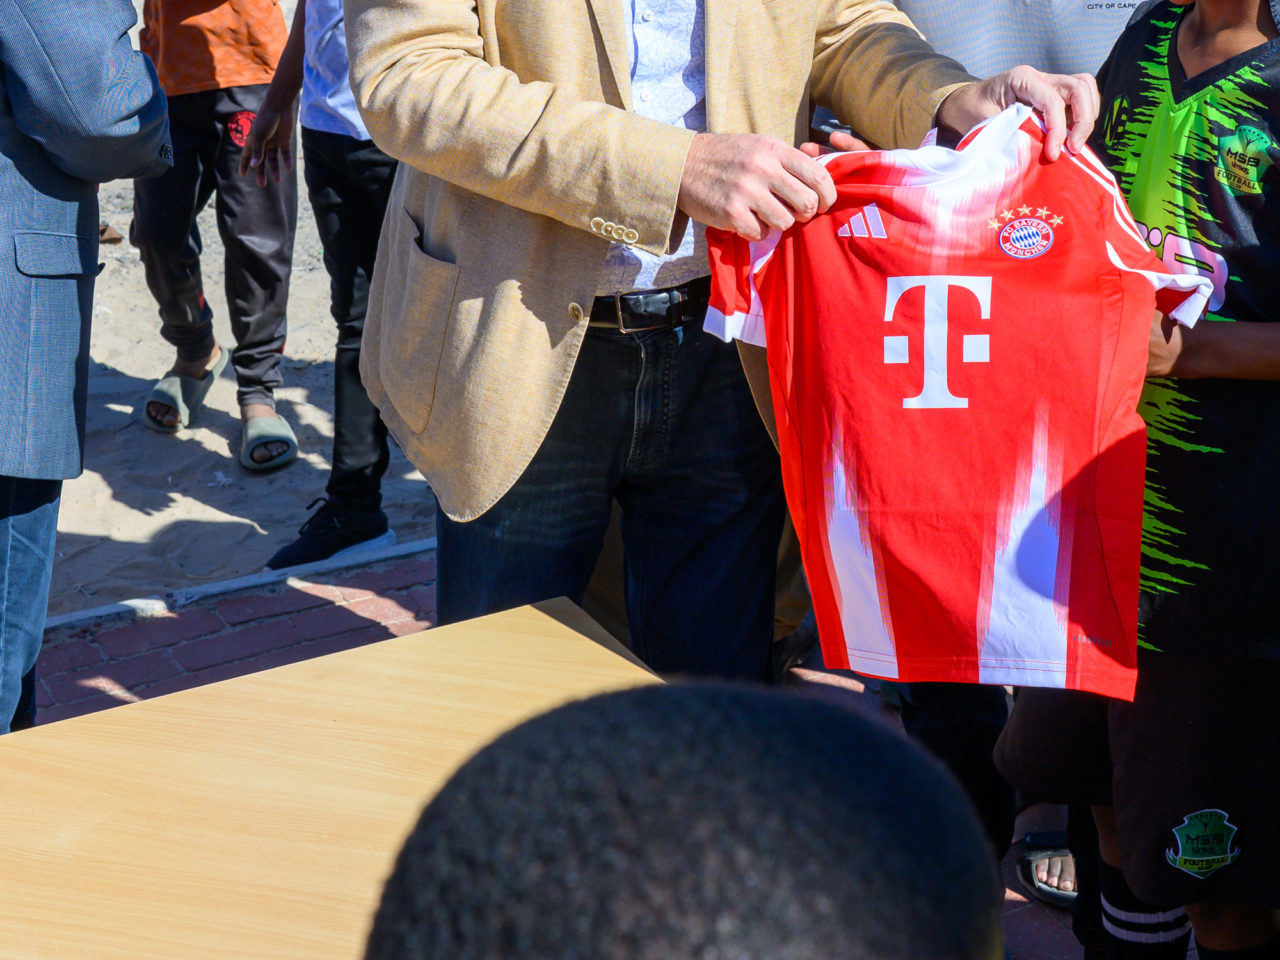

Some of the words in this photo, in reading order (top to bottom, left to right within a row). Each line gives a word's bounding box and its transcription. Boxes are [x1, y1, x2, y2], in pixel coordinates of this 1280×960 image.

[1226, 147, 1260, 168] MSB
[1217, 170, 1257, 190] FOOTBALL
[1003, 226, 1014, 237] FC
[1013, 220, 1049, 235] BAYERN
[884, 275, 992, 408] T
